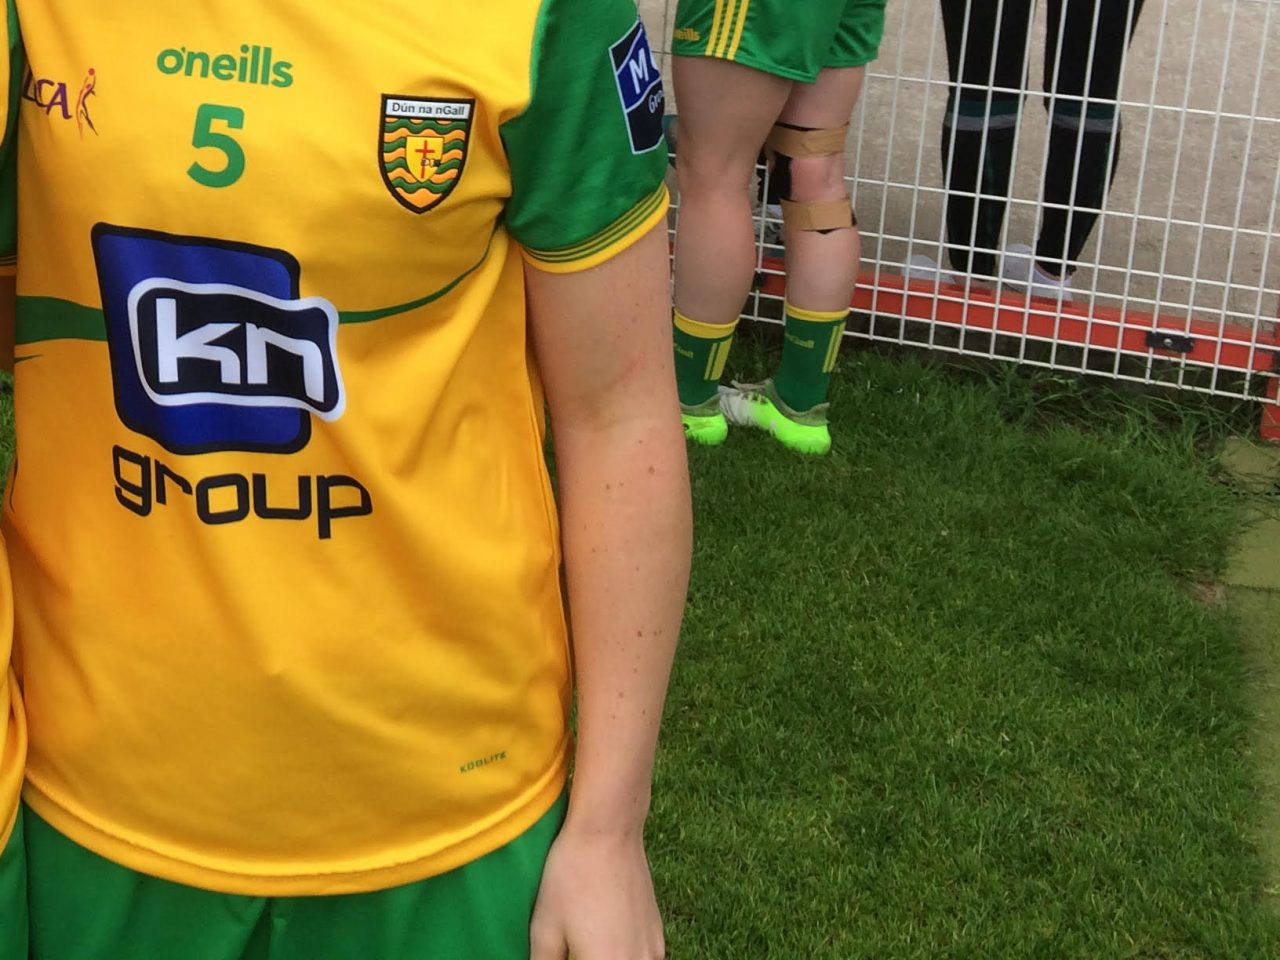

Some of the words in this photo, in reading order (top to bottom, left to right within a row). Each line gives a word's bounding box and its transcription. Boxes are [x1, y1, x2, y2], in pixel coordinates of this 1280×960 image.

[186, 102, 246, 189] 5
[391, 102, 415, 113] Dún
[418, 105, 433, 114] na
[435, 105, 465, 116] nGall
[155, 297, 325, 403] kn
[112, 444, 373, 540] group
[459, 751, 507, 774] KOOLITE
